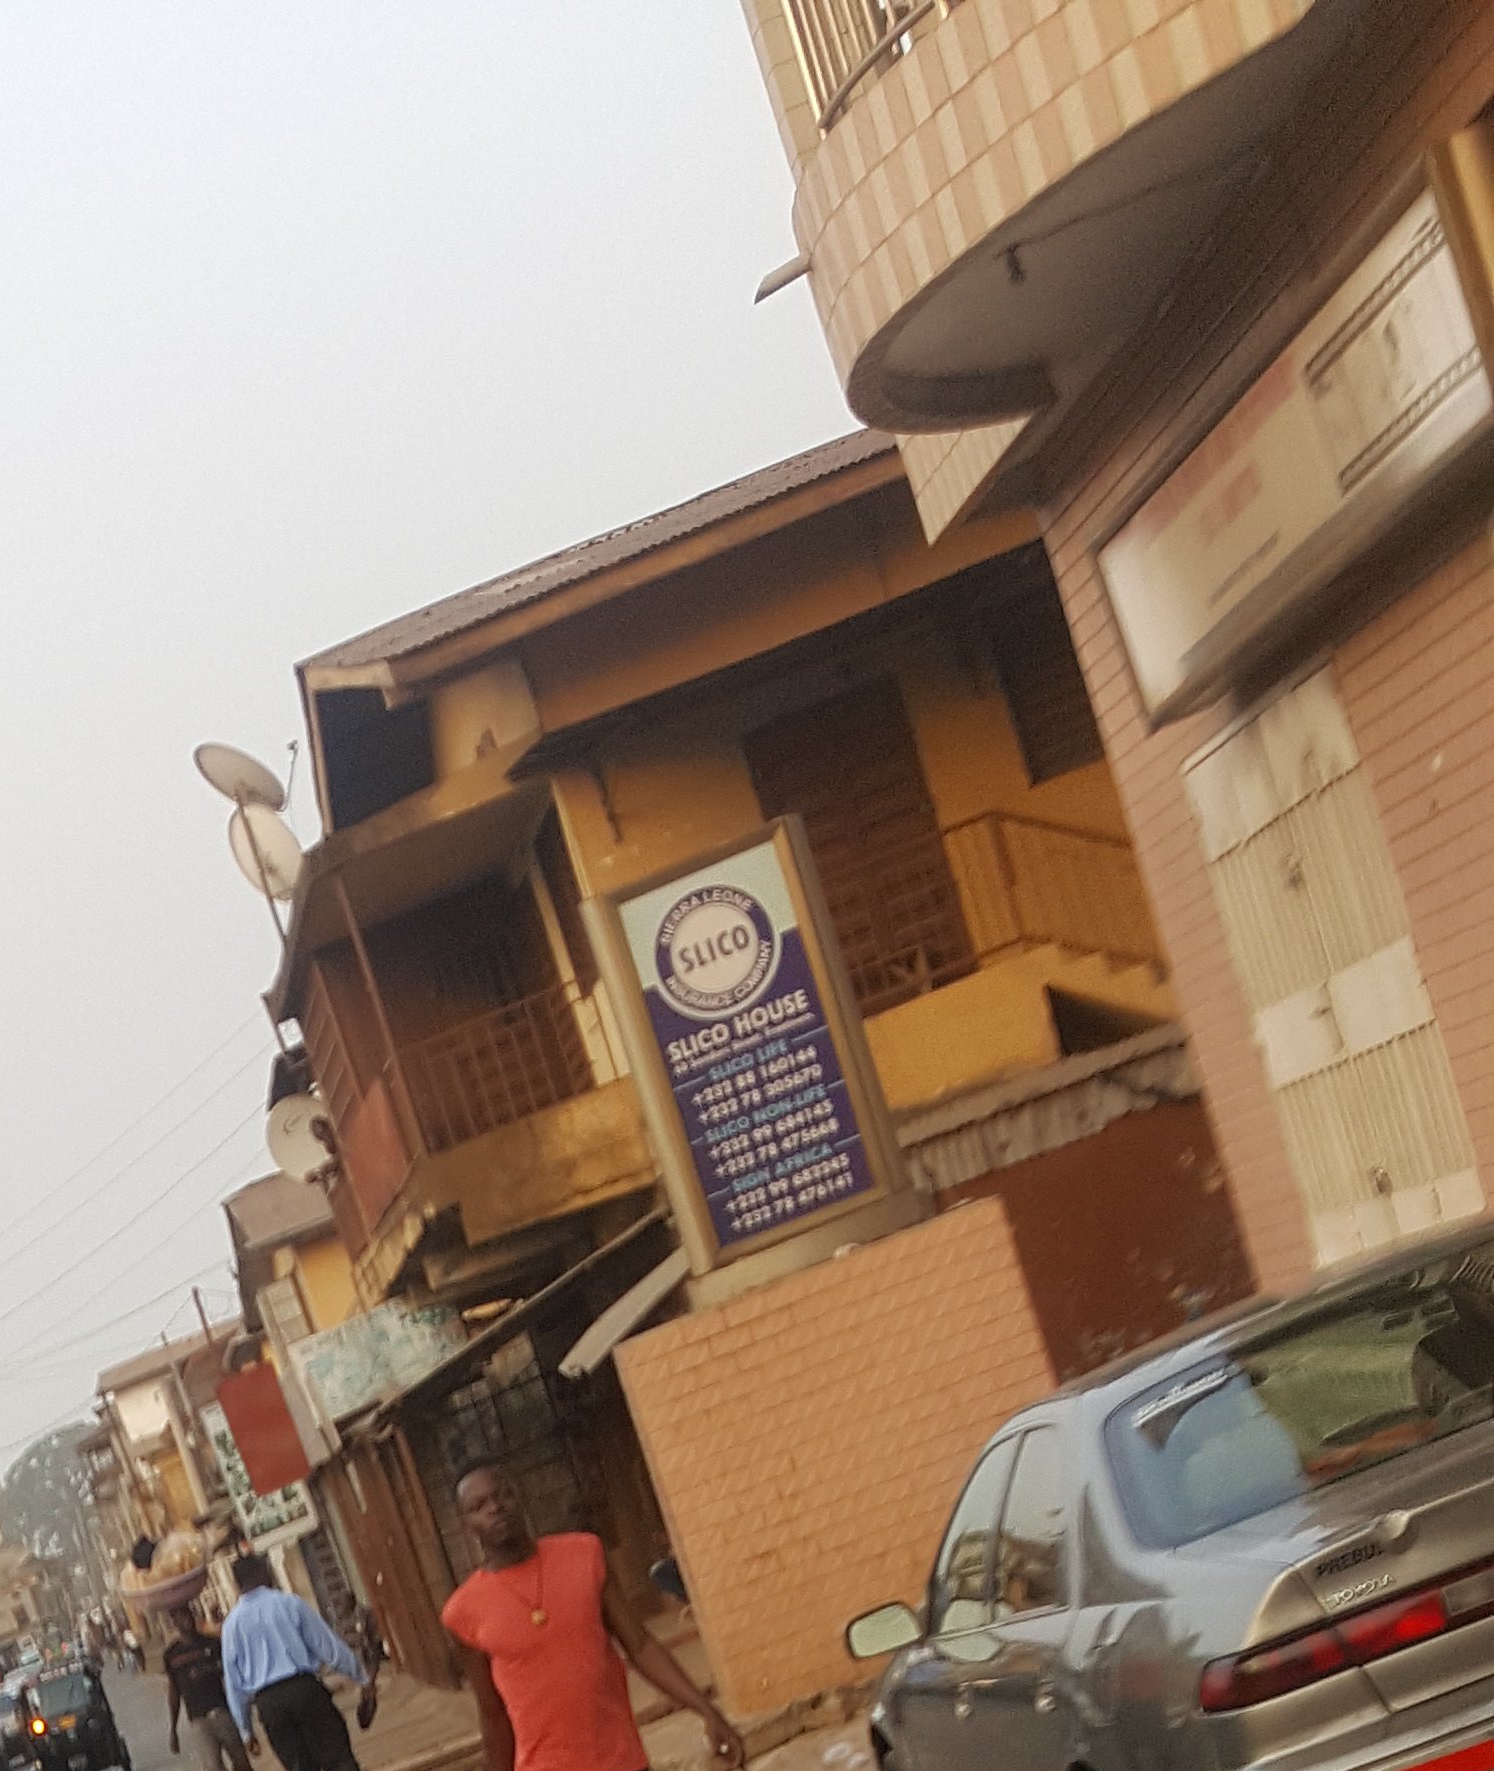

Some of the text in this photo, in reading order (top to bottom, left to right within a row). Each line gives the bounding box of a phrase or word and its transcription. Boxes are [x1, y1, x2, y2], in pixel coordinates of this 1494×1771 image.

[702, 889, 753, 911] LEONE
[679, 925, 749, 973] SLICO
[668, 1023, 730, 1063] SLICO
[733, 989, 809, 1037] HOUSE
[708, 1039, 788, 1080] SLICO LIFE
[705, 1116, 750, 1142] SLICO
